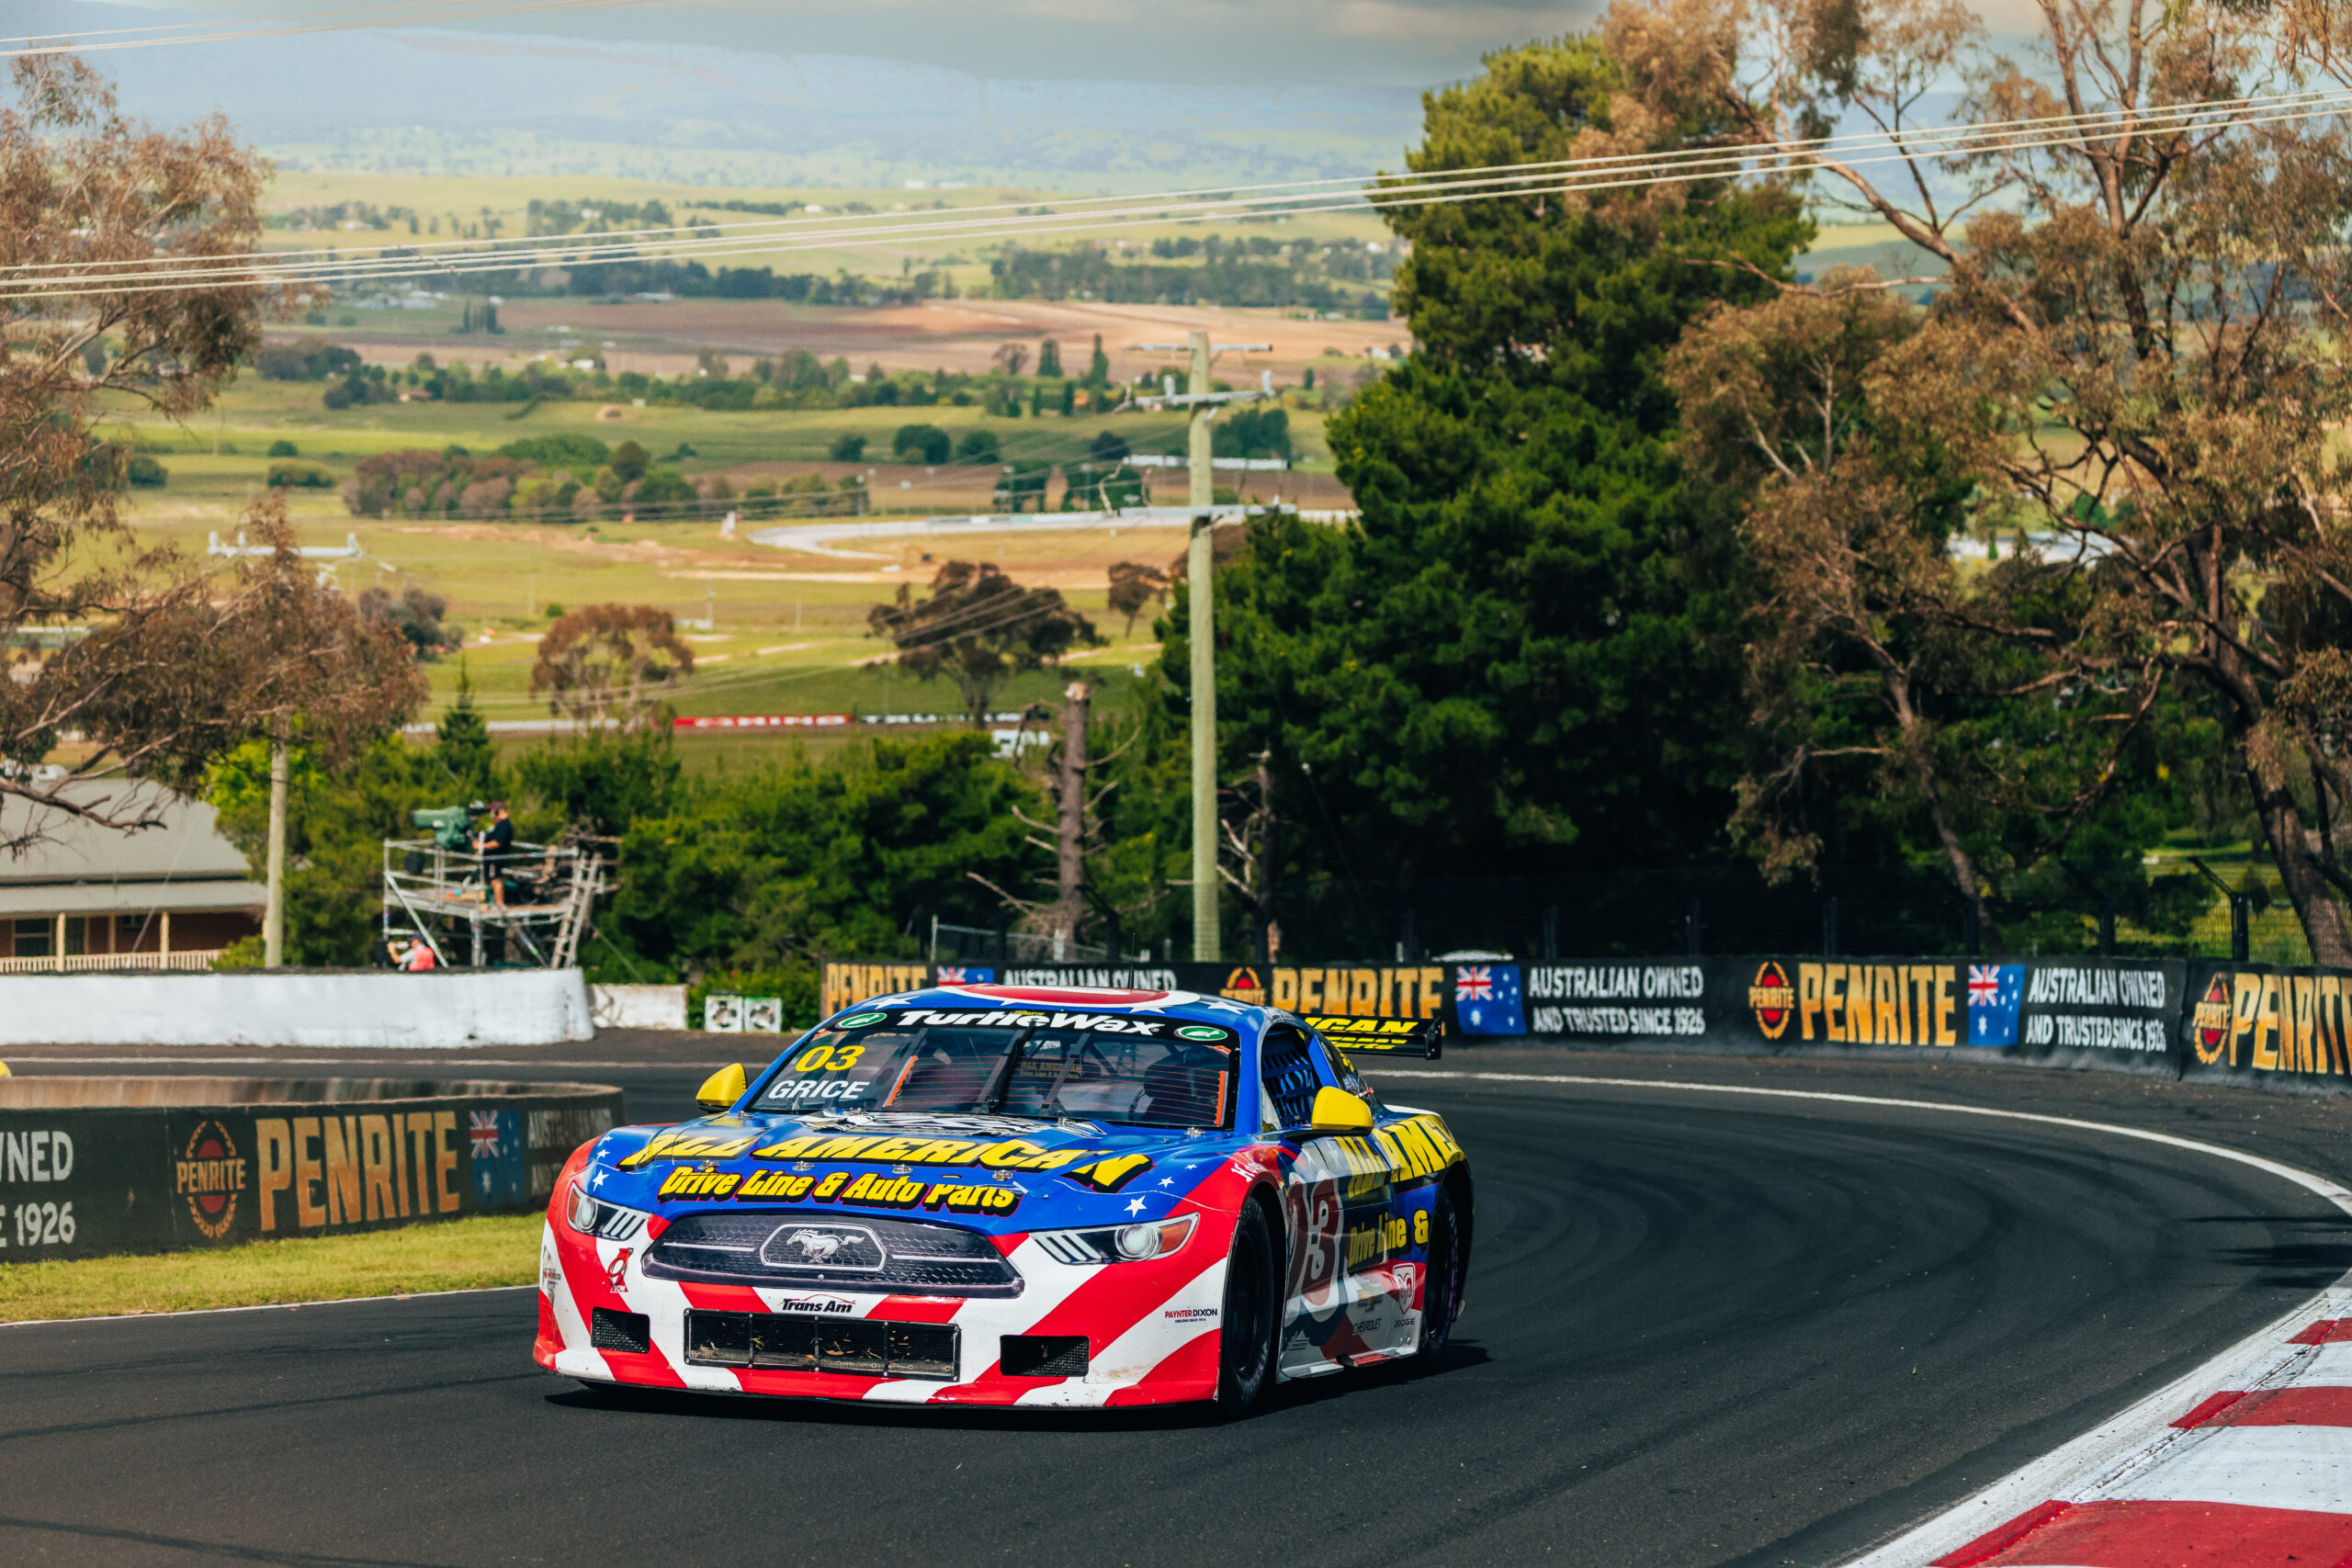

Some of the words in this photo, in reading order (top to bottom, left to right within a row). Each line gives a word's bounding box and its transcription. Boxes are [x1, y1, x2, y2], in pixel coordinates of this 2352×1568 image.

[1529, 966, 1640, 998] AUSTRALIAN
[1643, 965, 1703, 998] OWNED
[1748, 987, 1794, 1009] PENRITE
[2028, 967, 2118, 1006] AUSTRALIAN
[2119, 969, 2165, 1009] OWNED
[1533, 1007, 1563, 1032] AND
[1563, 1007, 1629, 1033] TRUSTED
[1629, 1008, 1672, 1034] SINCE
[1674, 1007, 1706, 1035] 1926
[1799, 963, 1956, 1046] PENRITE
[2026, 1014, 2053, 1044] AND
[2055, 1015, 2112, 1047] TRUSTED
[2113, 1017, 2144, 1050] SINCE
[795, 1045, 865, 1072] 03
[768, 1079, 870, 1100] GRICE
[0, 1131, 74, 1182] NED
[255, 1111, 460, 1232] PENRITE
[616, 1134, 761, 1170] ALL
[750, 1135, 1151, 1189] AMERICAN
[176, 1159, 245, 1193] PENRITE
[658, 1166, 742, 1198] Drive
[736, 1169, 816, 1198] Line
[812, 1171, 853, 1198] &
[842, 1173, 924, 1202] Auto
[923, 1180, 1017, 1209] Parts
[15, 1201, 75, 1246] 1926
[1348, 1222, 1375, 1268] Drive
[1377, 1211, 1407, 1253] Line
[1413, 1209, 1429, 1245] &
[783, 1298, 823, 1312] Trans
[823, 1300, 853, 1314] Am
[1165, 1309, 1193, 1318] PAYNTER
[1193, 1308, 1218, 1317] DIXON
[1394, 1317, 1416, 1328] DODGE
[1353, 1317, 1382, 1335] CHEVROLET
